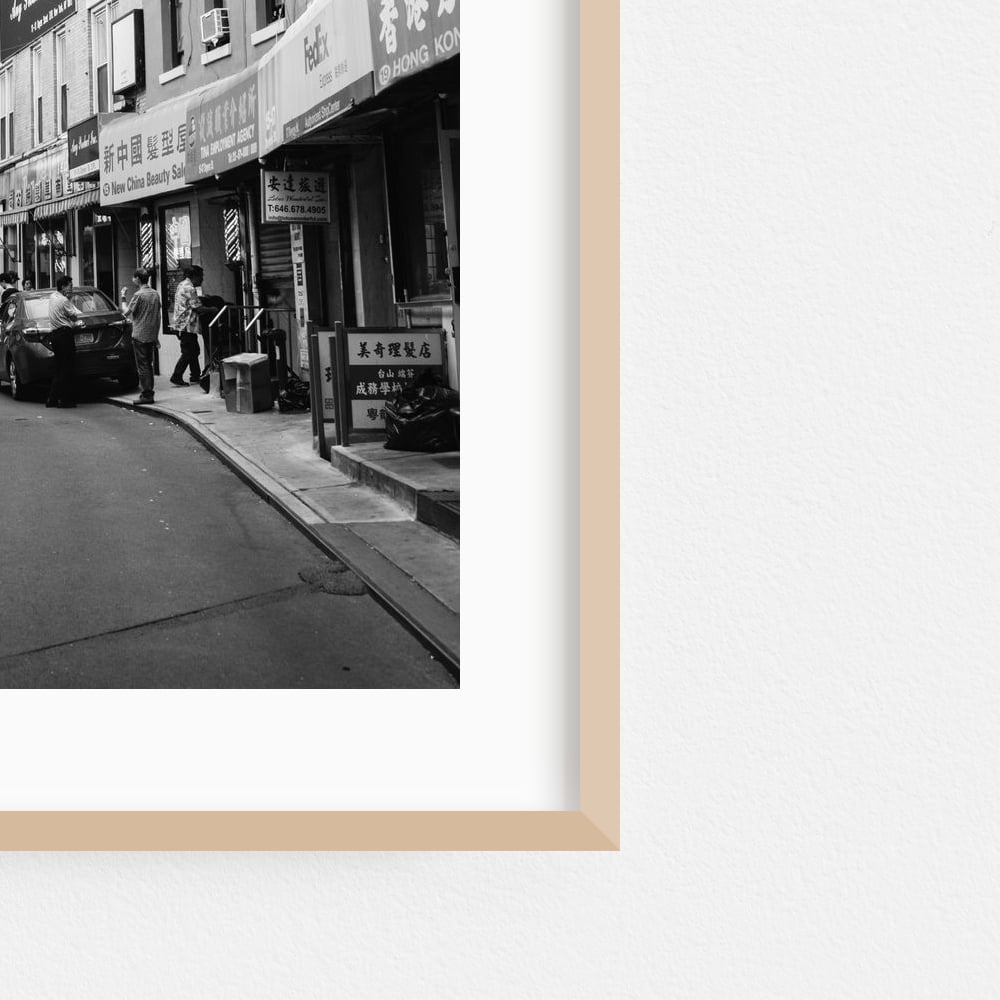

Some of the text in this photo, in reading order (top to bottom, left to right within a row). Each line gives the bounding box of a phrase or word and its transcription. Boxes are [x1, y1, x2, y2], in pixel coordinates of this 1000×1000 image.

[304, 23, 329, 75] FedEx
[393, 45, 429, 78] HONG
[104, 123, 186, 174] 新中國髮型屋
[112, 181, 126, 196] New
[127, 175, 145, 192] China
[147, 168, 170, 187] Beauty
[268, 204, 326, 214] T:646.678.4905
[357, 341, 432, 359] 美奇理髮店
